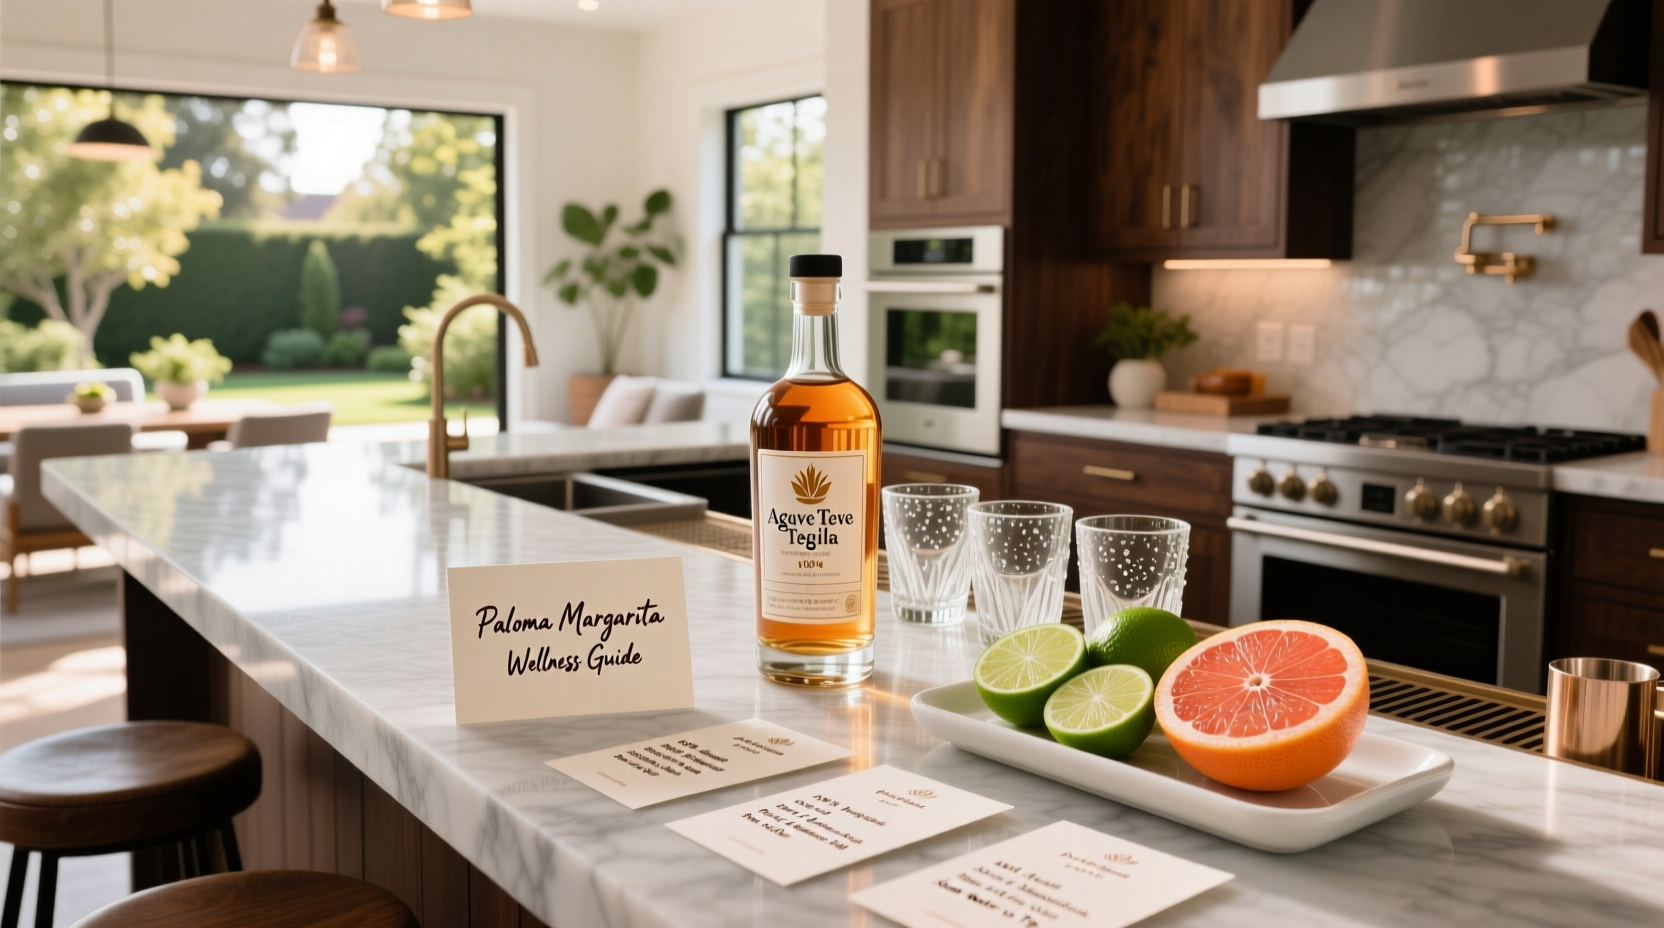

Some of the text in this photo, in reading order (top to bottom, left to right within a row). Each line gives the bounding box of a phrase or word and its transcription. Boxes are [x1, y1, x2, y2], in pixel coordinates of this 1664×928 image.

[817, 508, 854, 526] Teve
[476, 598, 665, 642] Paloma Margarita
[507, 642, 643, 676] Wellness Guide
